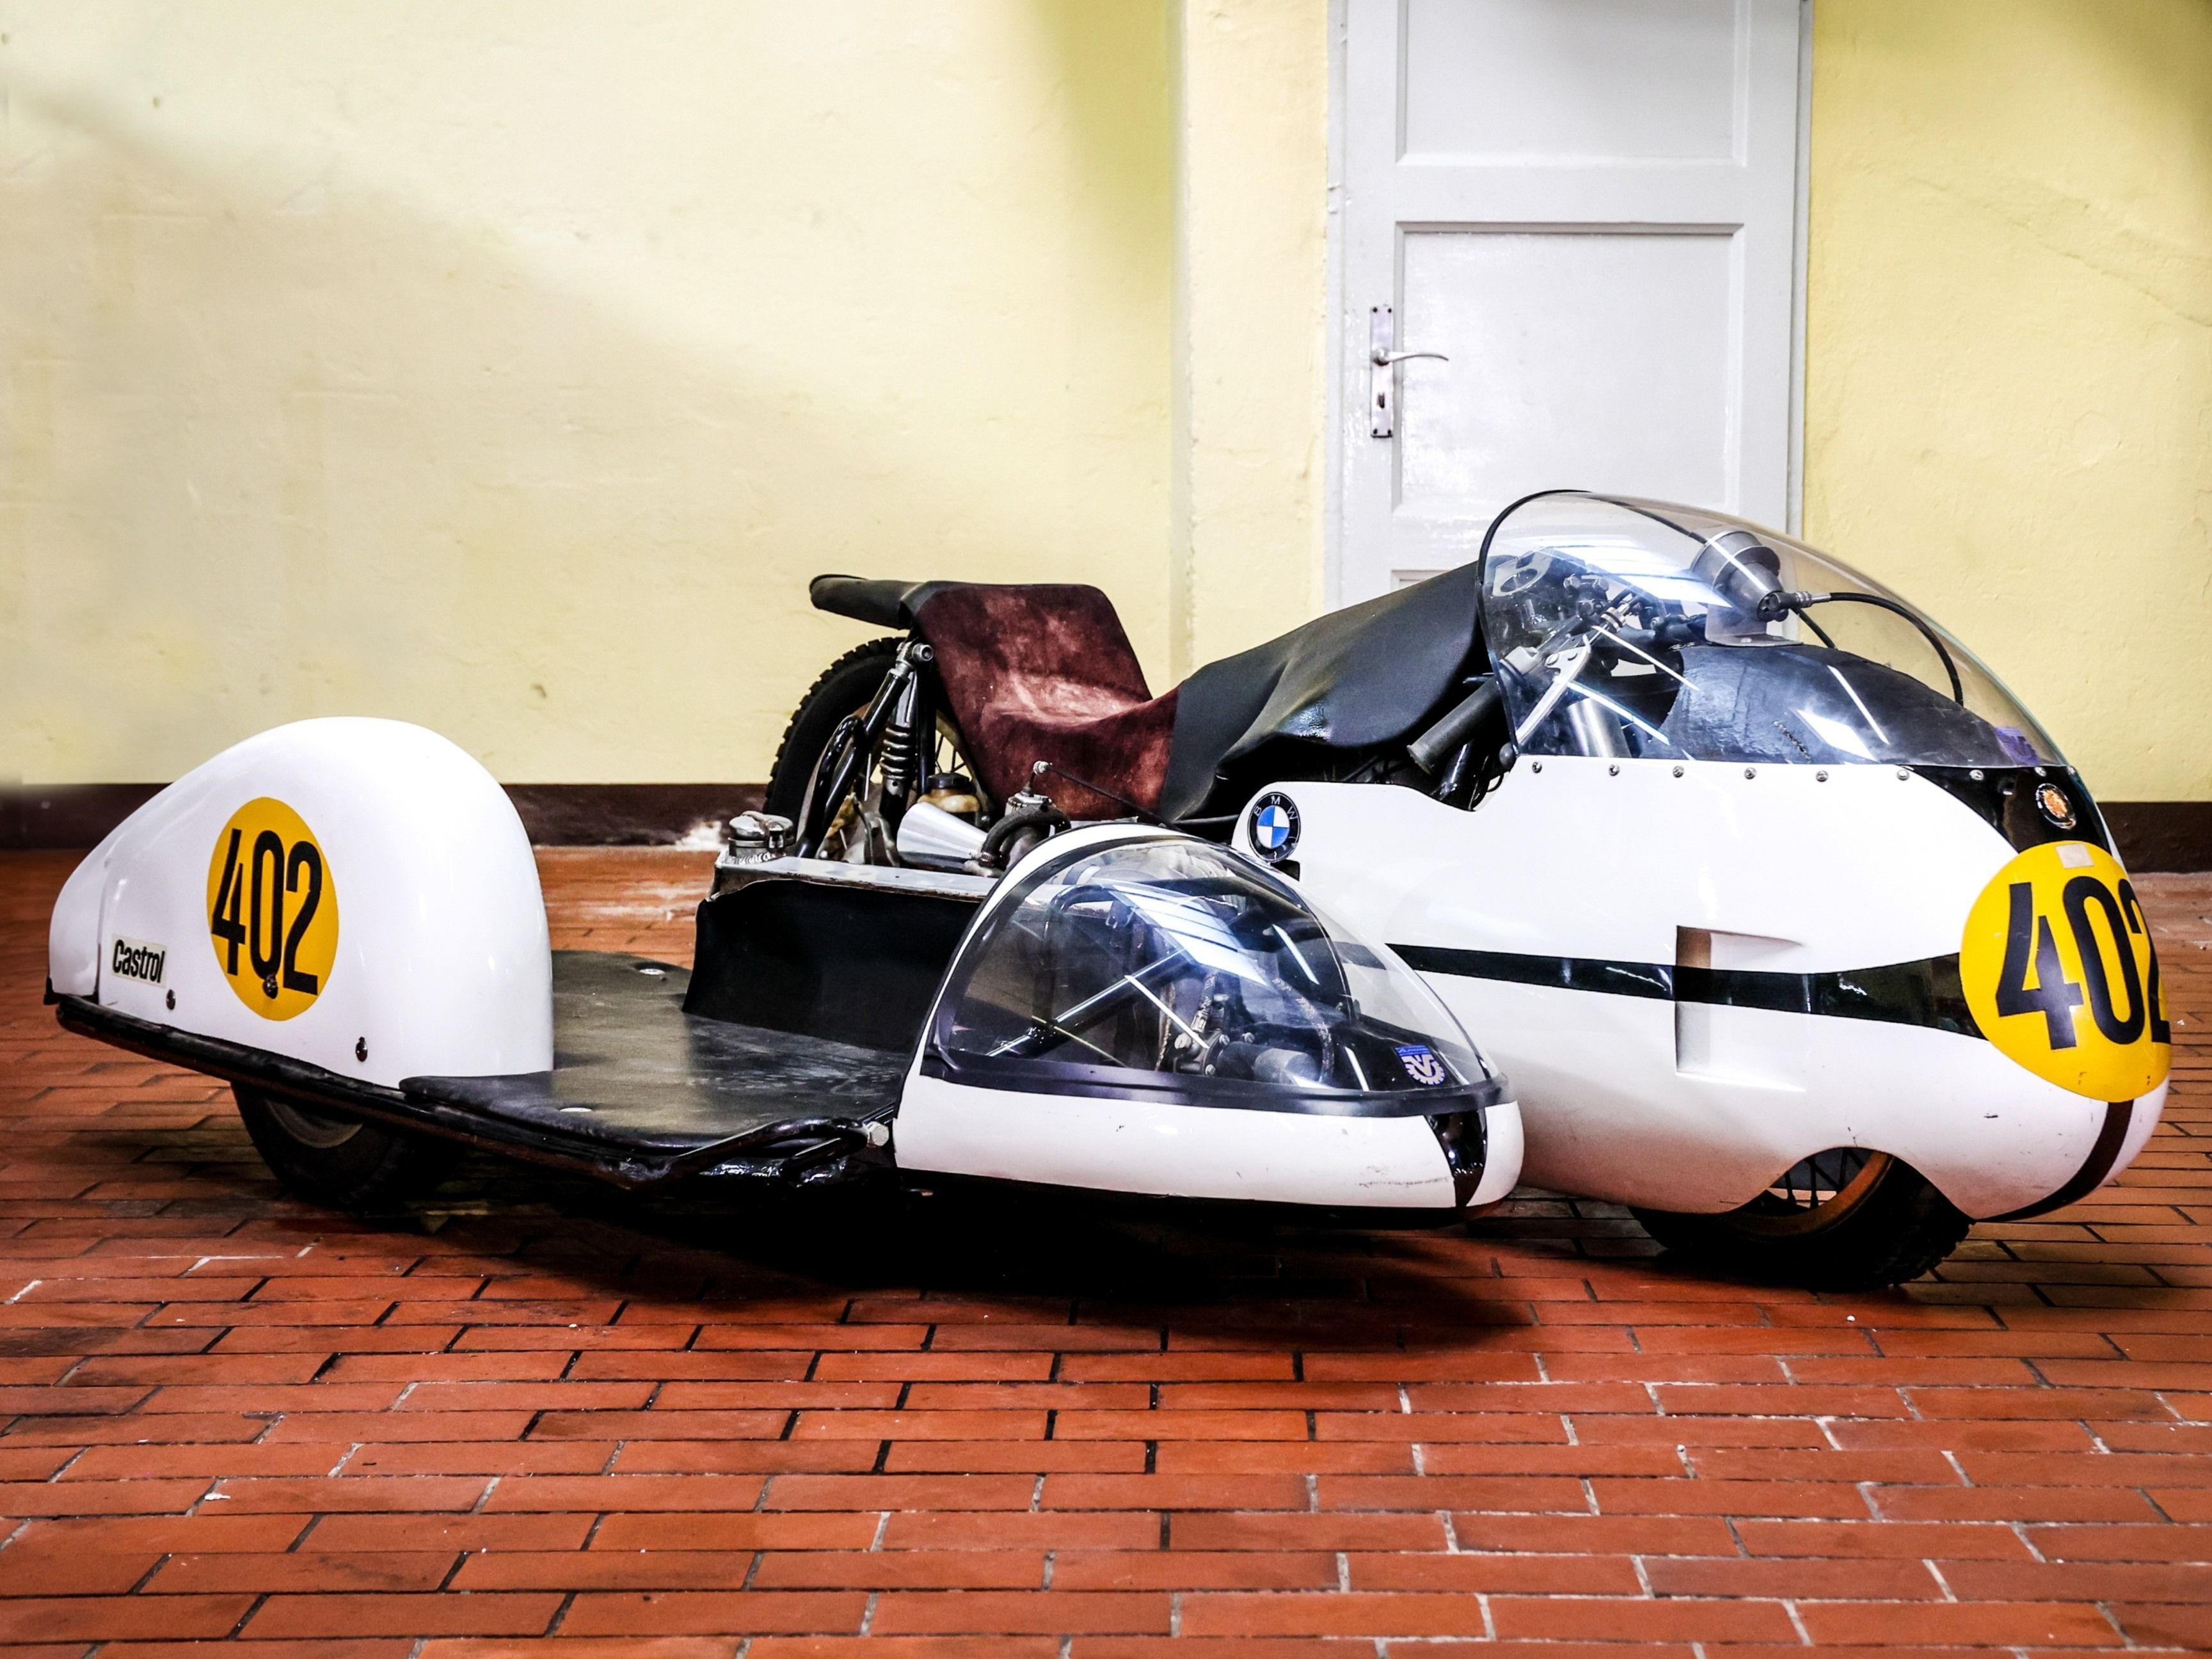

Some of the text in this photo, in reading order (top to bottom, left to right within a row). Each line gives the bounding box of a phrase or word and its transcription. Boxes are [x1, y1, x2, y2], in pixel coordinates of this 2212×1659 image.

[1253, 795, 1298, 820] BMW
[211, 828, 322, 996] 402
[113, 939, 165, 983] Castrol
